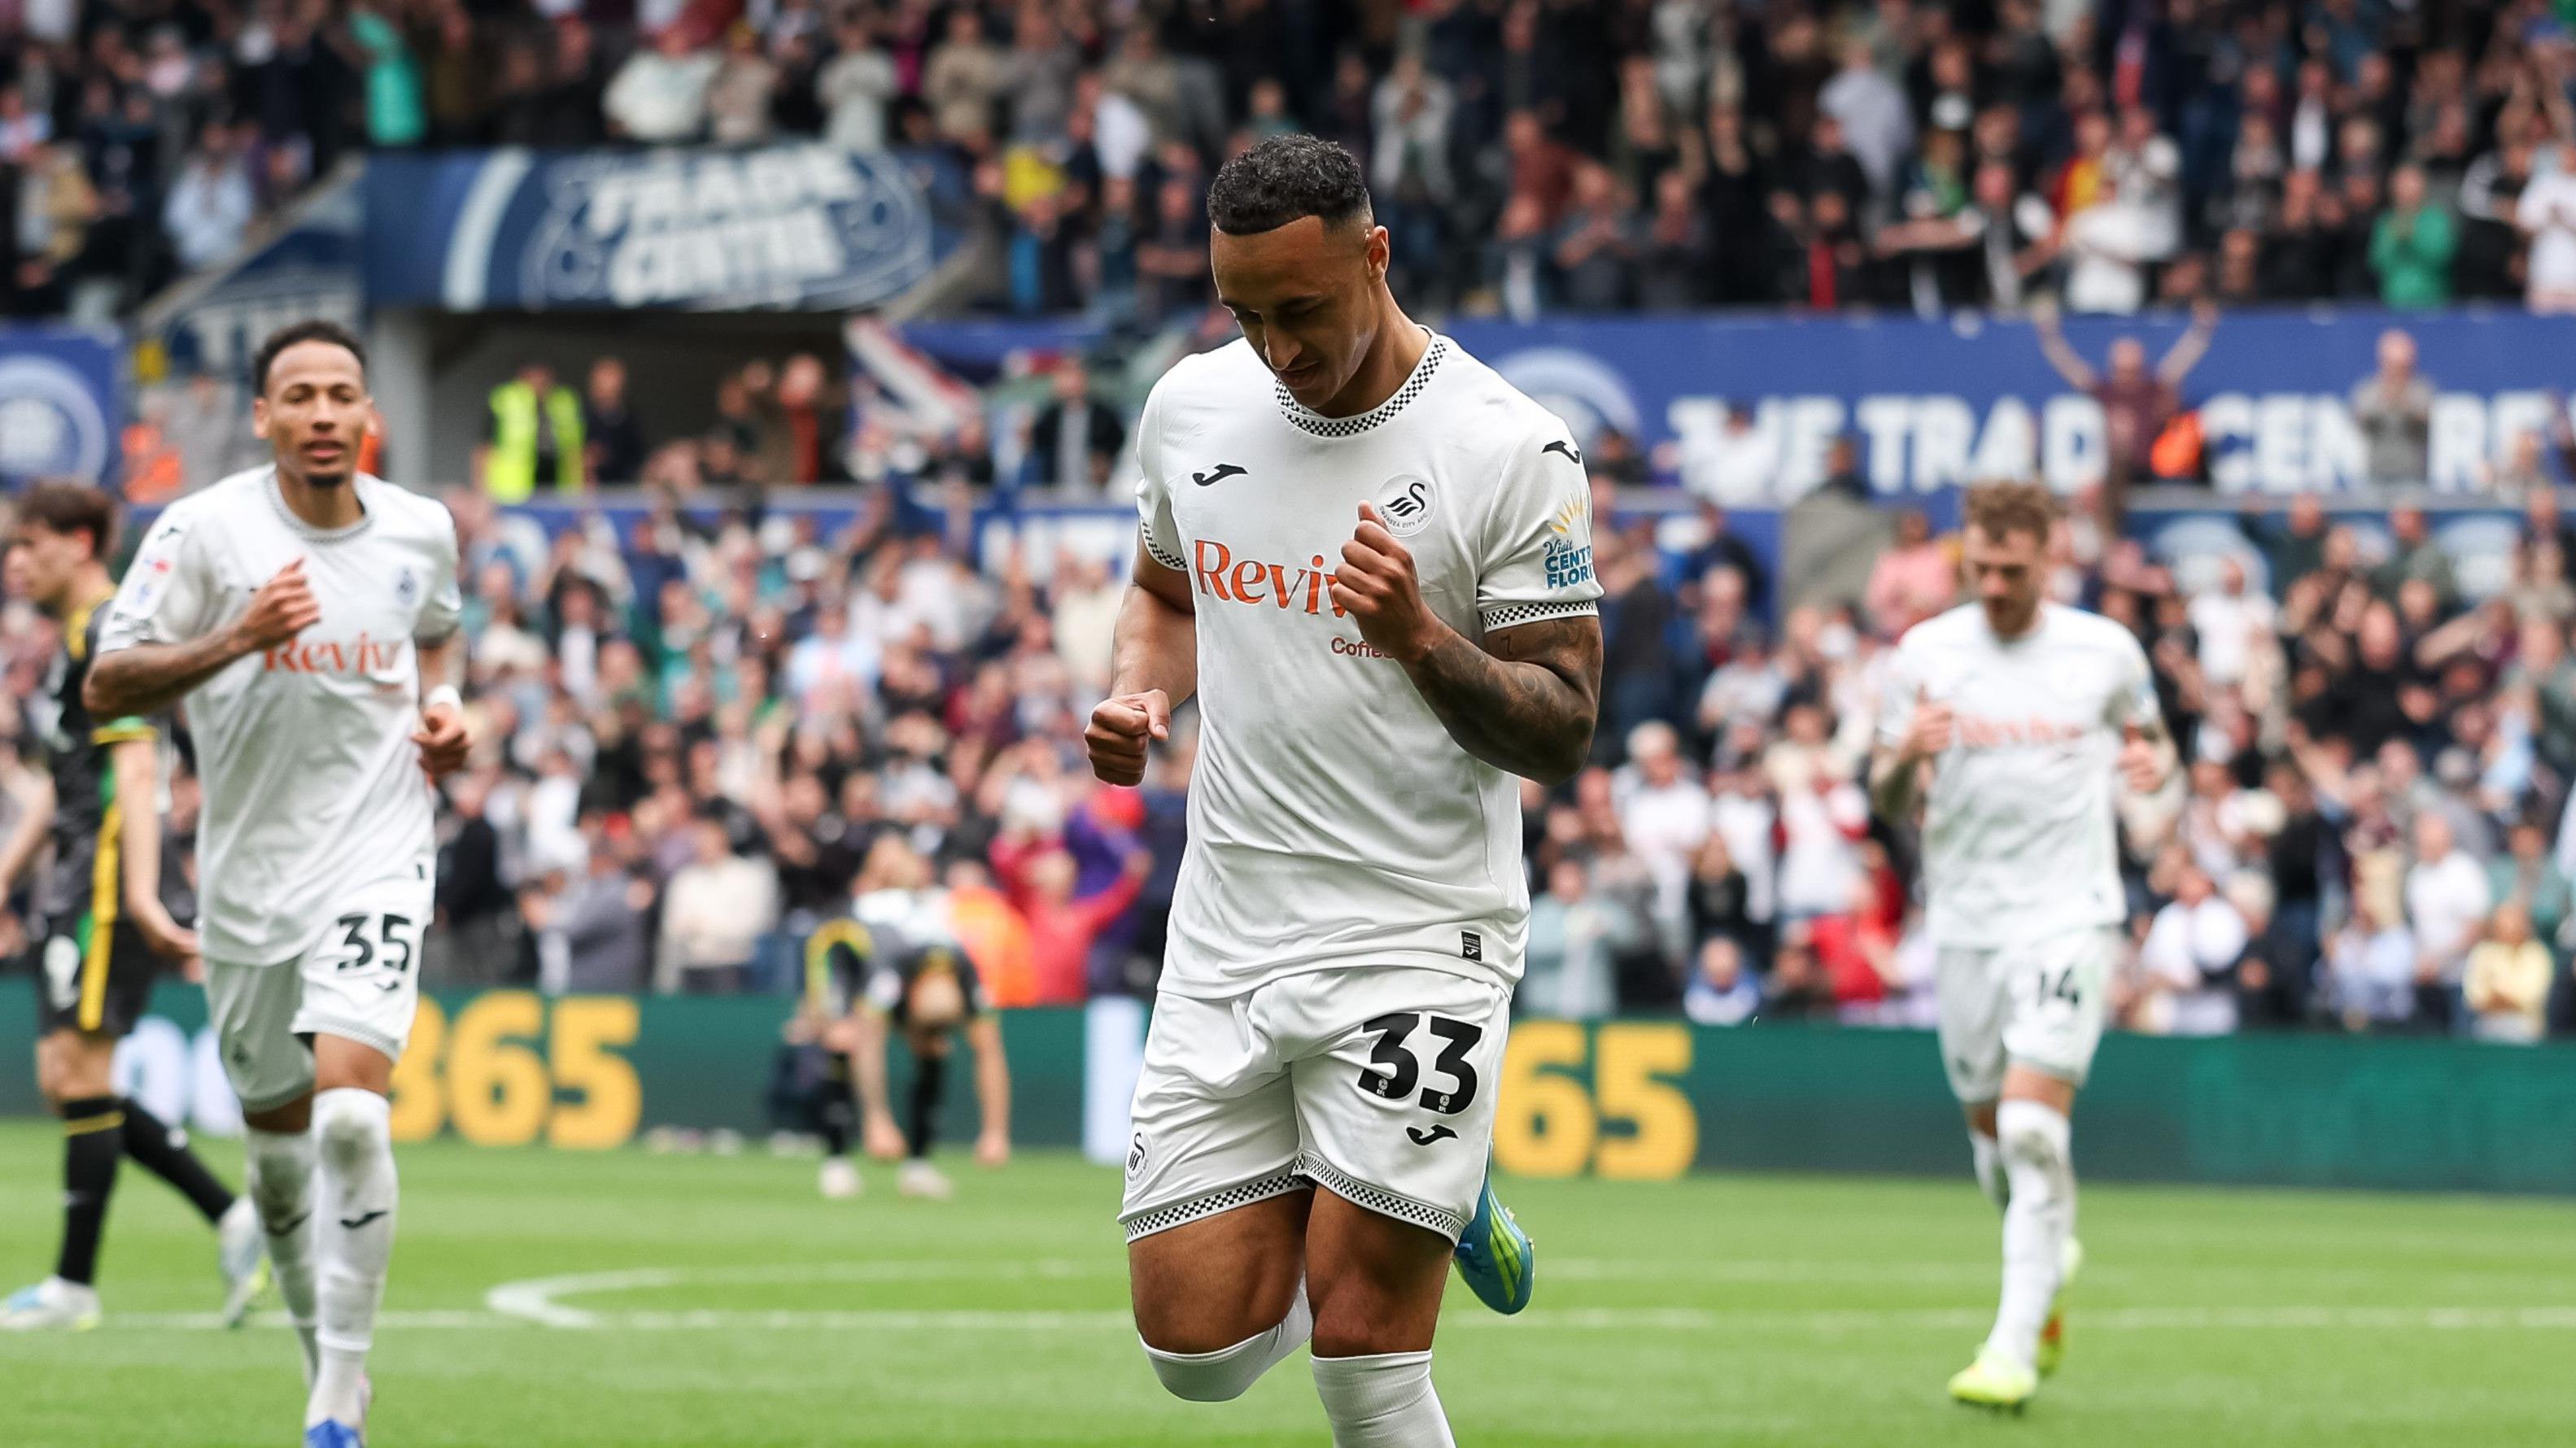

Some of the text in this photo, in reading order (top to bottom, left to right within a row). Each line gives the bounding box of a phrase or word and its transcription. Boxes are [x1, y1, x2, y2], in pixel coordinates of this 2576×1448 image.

[1857, 395, 2111, 493] TRAD
[1543, 539, 1574, 557] Visit
[336, 911, 413, 972] 35
[2037, 963, 2081, 1010] 14
[1357, 1012, 1483, 1115] 33
